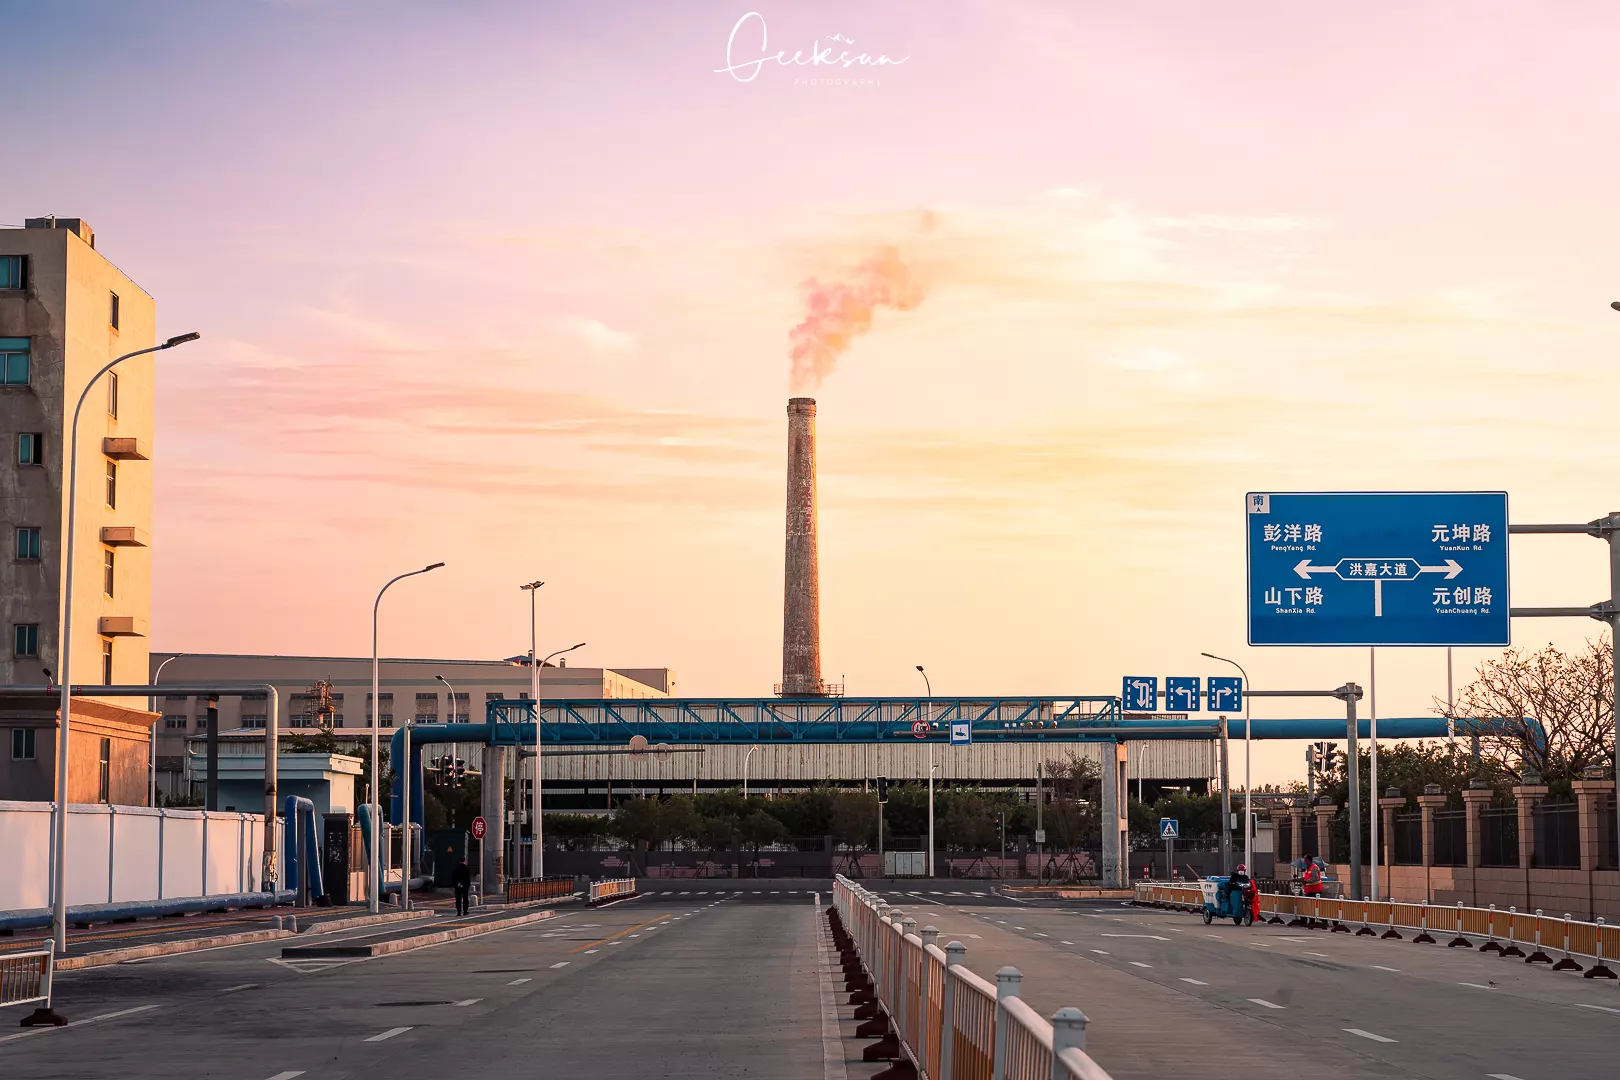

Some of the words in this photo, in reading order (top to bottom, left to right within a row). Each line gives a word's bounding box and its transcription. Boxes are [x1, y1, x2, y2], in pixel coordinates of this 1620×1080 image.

[1253, 495, 1264, 506] 南
[1263, 523, 1323, 543] 彭洋路
[1431, 523, 1492, 543] 元坤路
[1349, 562, 1408, 576] 洪嘉大道
[1264, 586, 1324, 606] 山下路
[1432, 586, 1493, 606] 元创路
[1435, 607, 1478, 615] YuanChuang
[475, 821, 484, 835] 停
